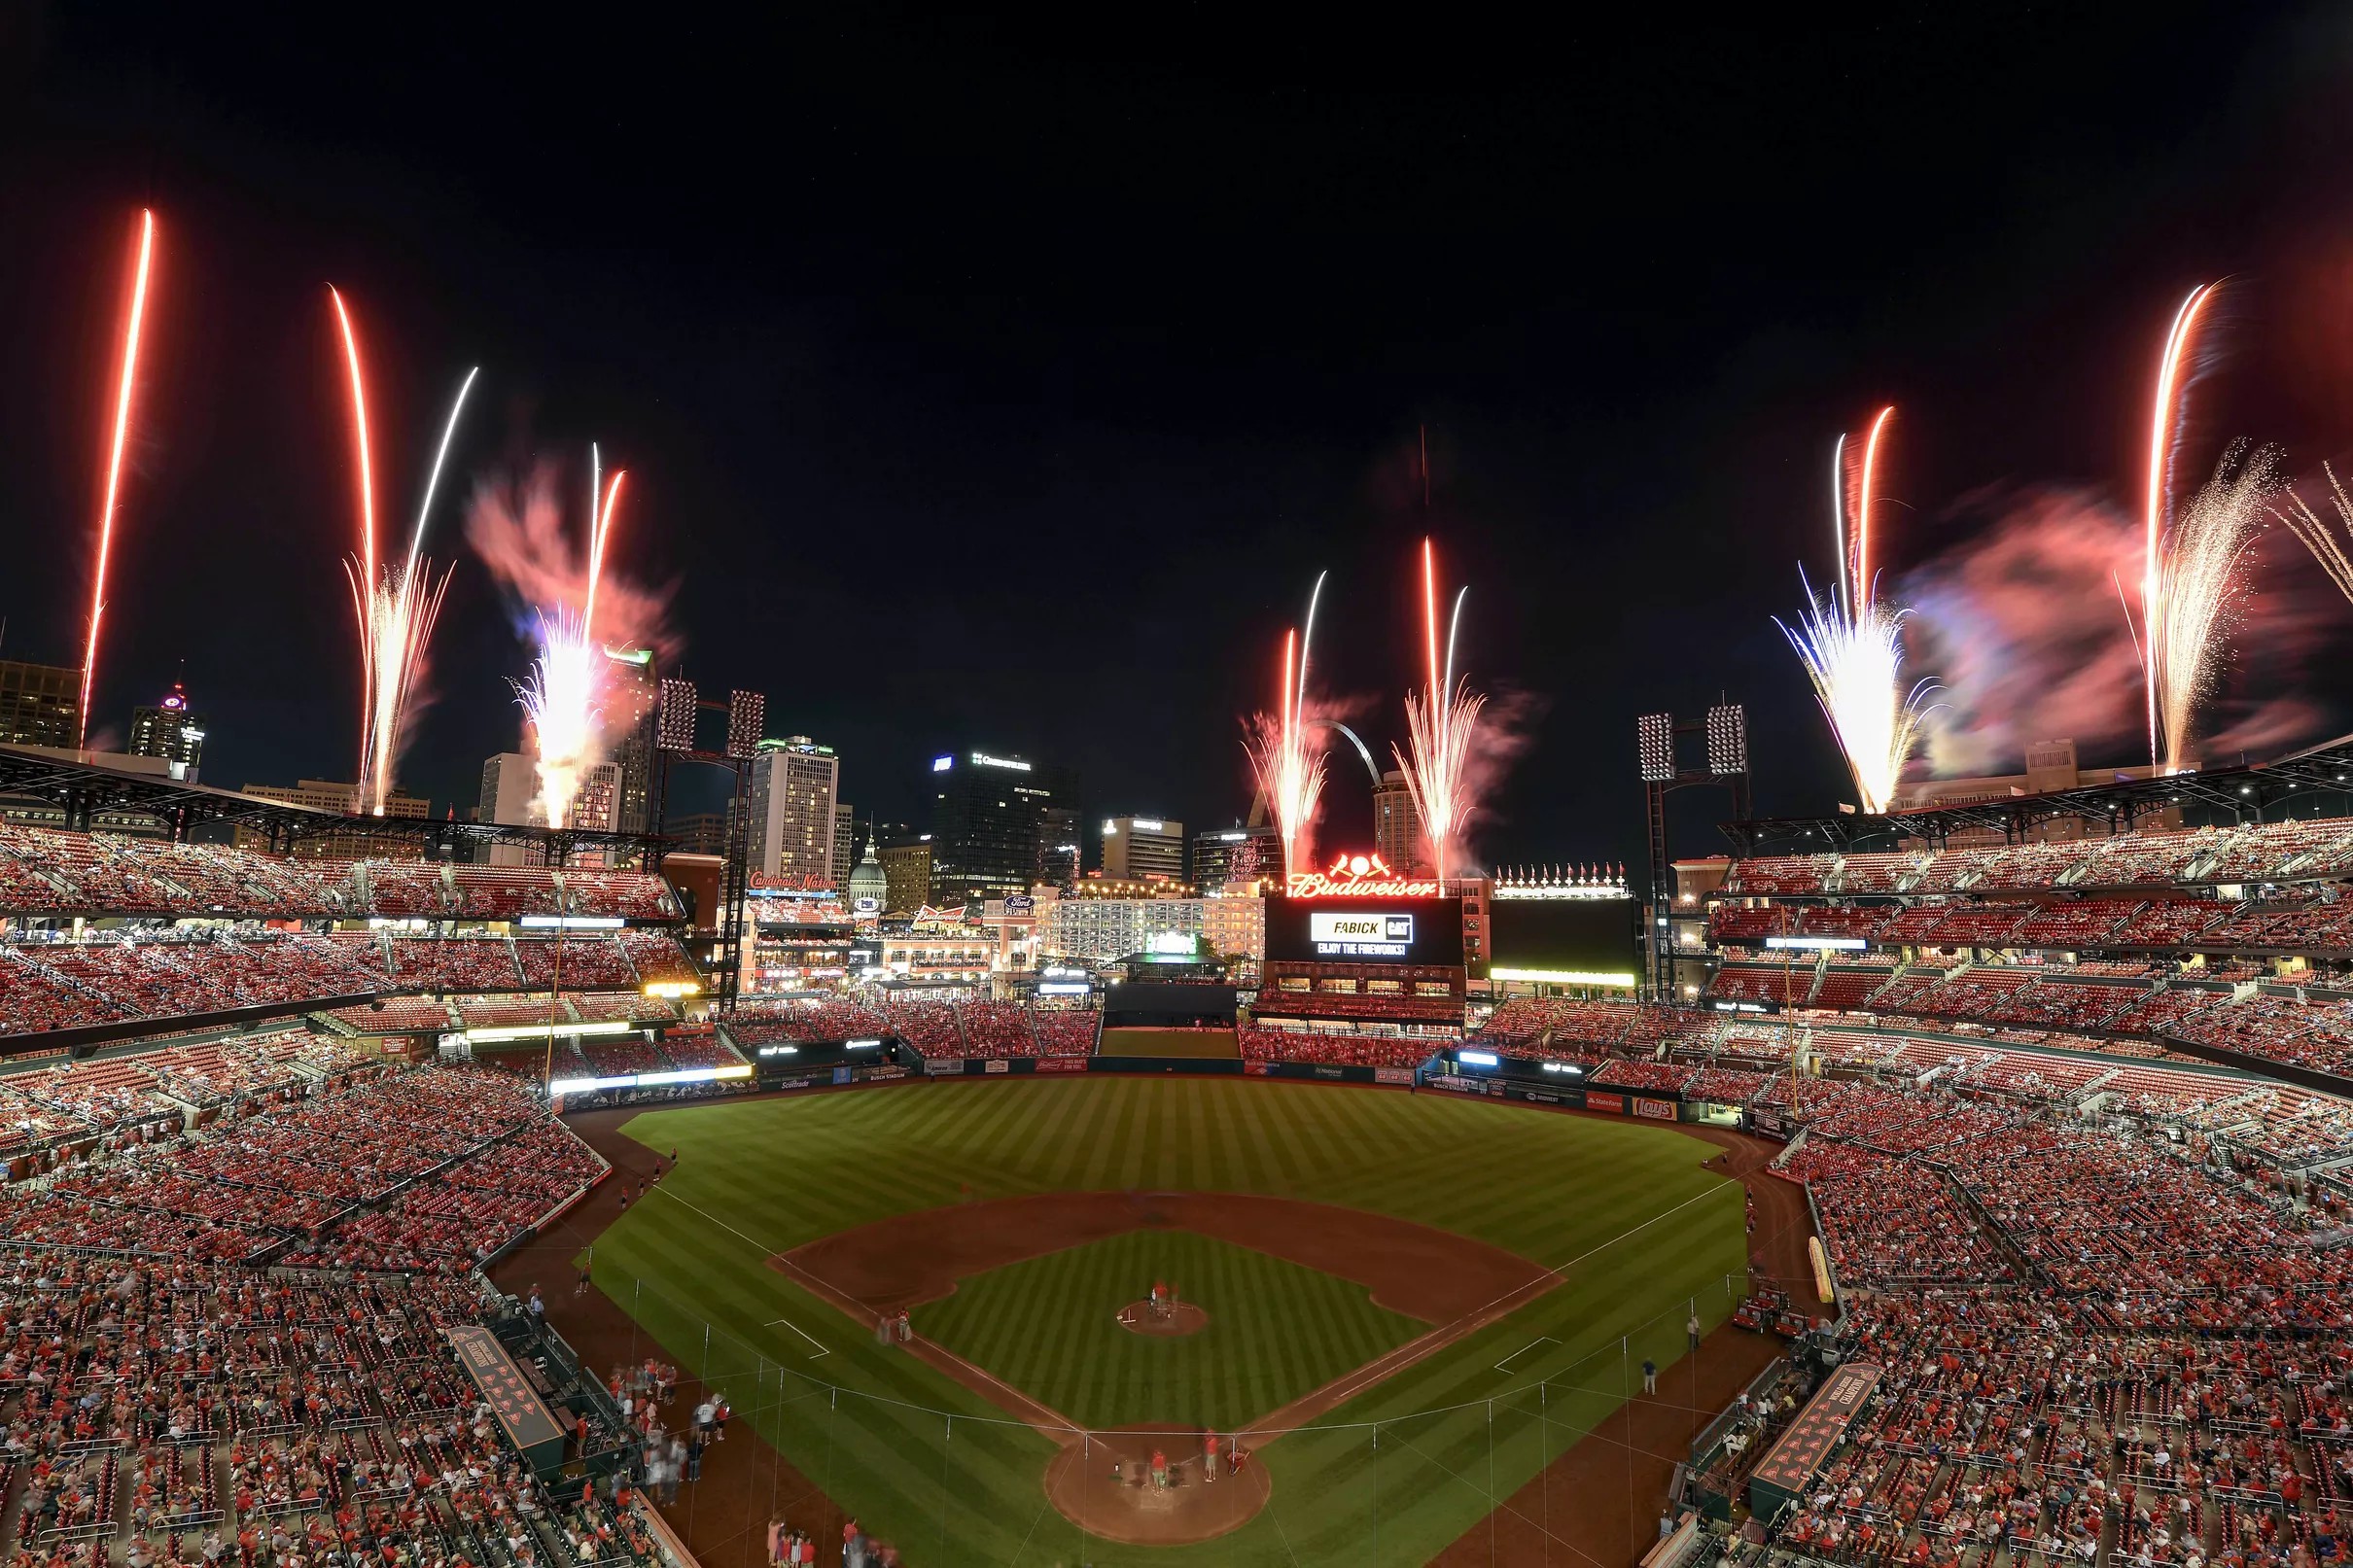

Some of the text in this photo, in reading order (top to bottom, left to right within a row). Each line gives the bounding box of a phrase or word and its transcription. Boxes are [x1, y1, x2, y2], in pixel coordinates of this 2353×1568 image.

[750, 871, 837, 890] Cardinals Nation
[1287, 873, 1437, 898] Budweiser
[1011, 897, 1031, 907] Ford
[914, 911, 965, 922] Budweiser
[1334, 922, 1410, 935] FABICK CAT
[1317, 943, 1406, 956] ENJOY THE FIREWORKS!
[781, 1080, 810, 1090] Scottrade
